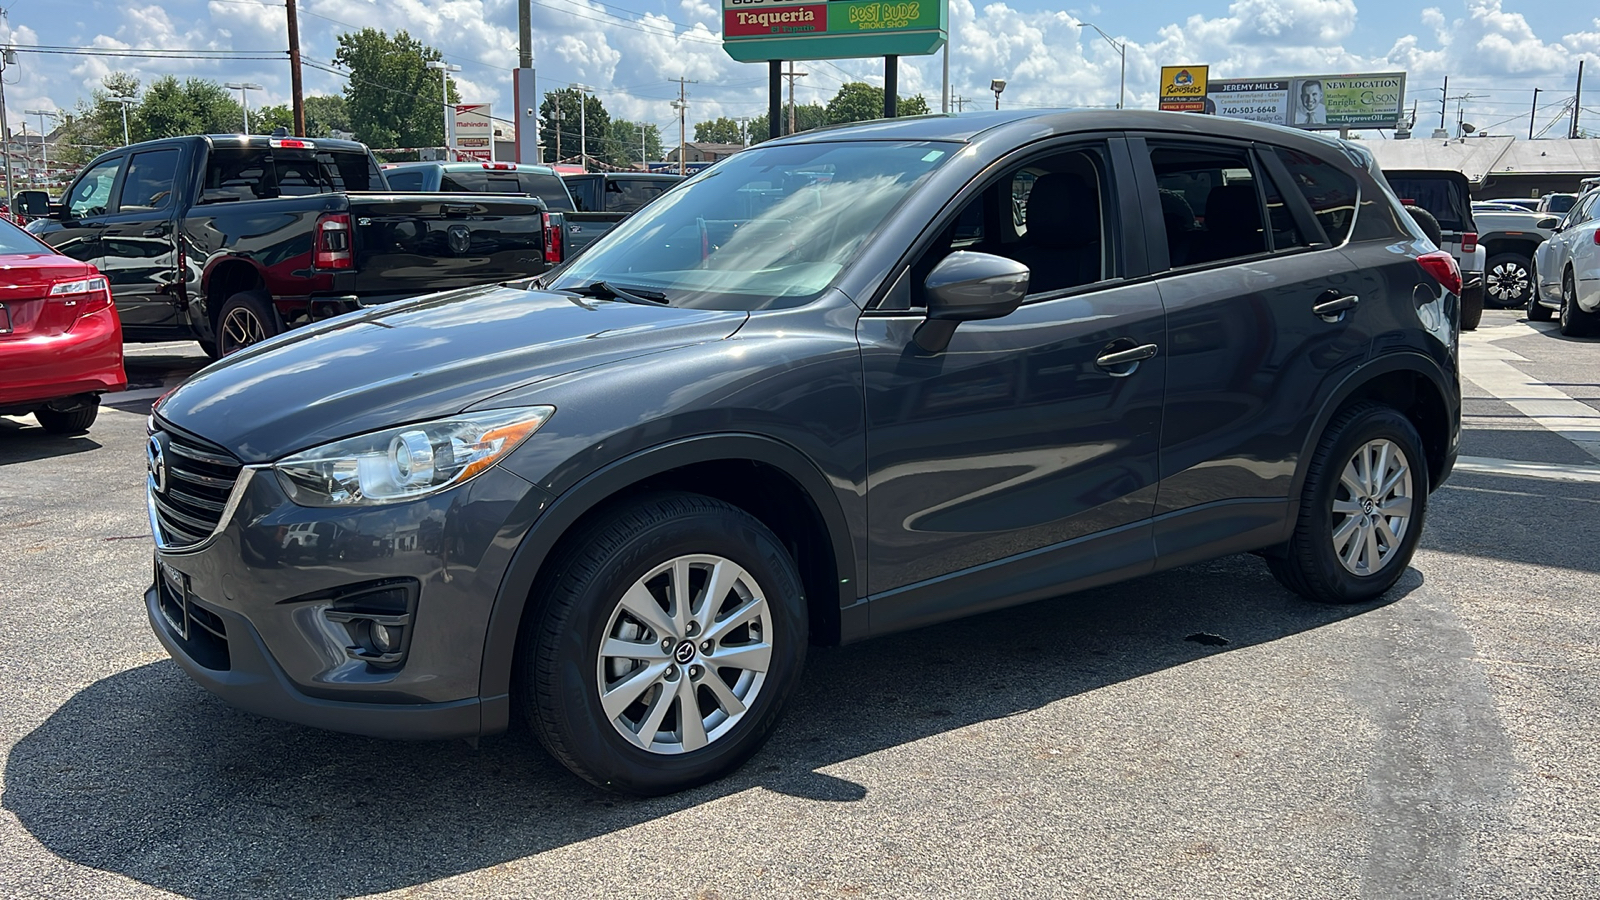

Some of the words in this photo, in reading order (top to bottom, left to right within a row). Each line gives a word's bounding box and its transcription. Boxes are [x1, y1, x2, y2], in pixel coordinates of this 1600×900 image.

[882, 1, 919, 20] BUDZ
[737, 7, 815, 27] Taquería
[859, 21, 885, 29] SMOKE
[887, 20, 908, 28] SHOP
[1349, 80, 1398, 88] LOCATION
[1165, 84, 1202, 95] Roosters
[1327, 98, 1356, 107] Enright
[1223, 106, 1277, 114] 740-503-6648
